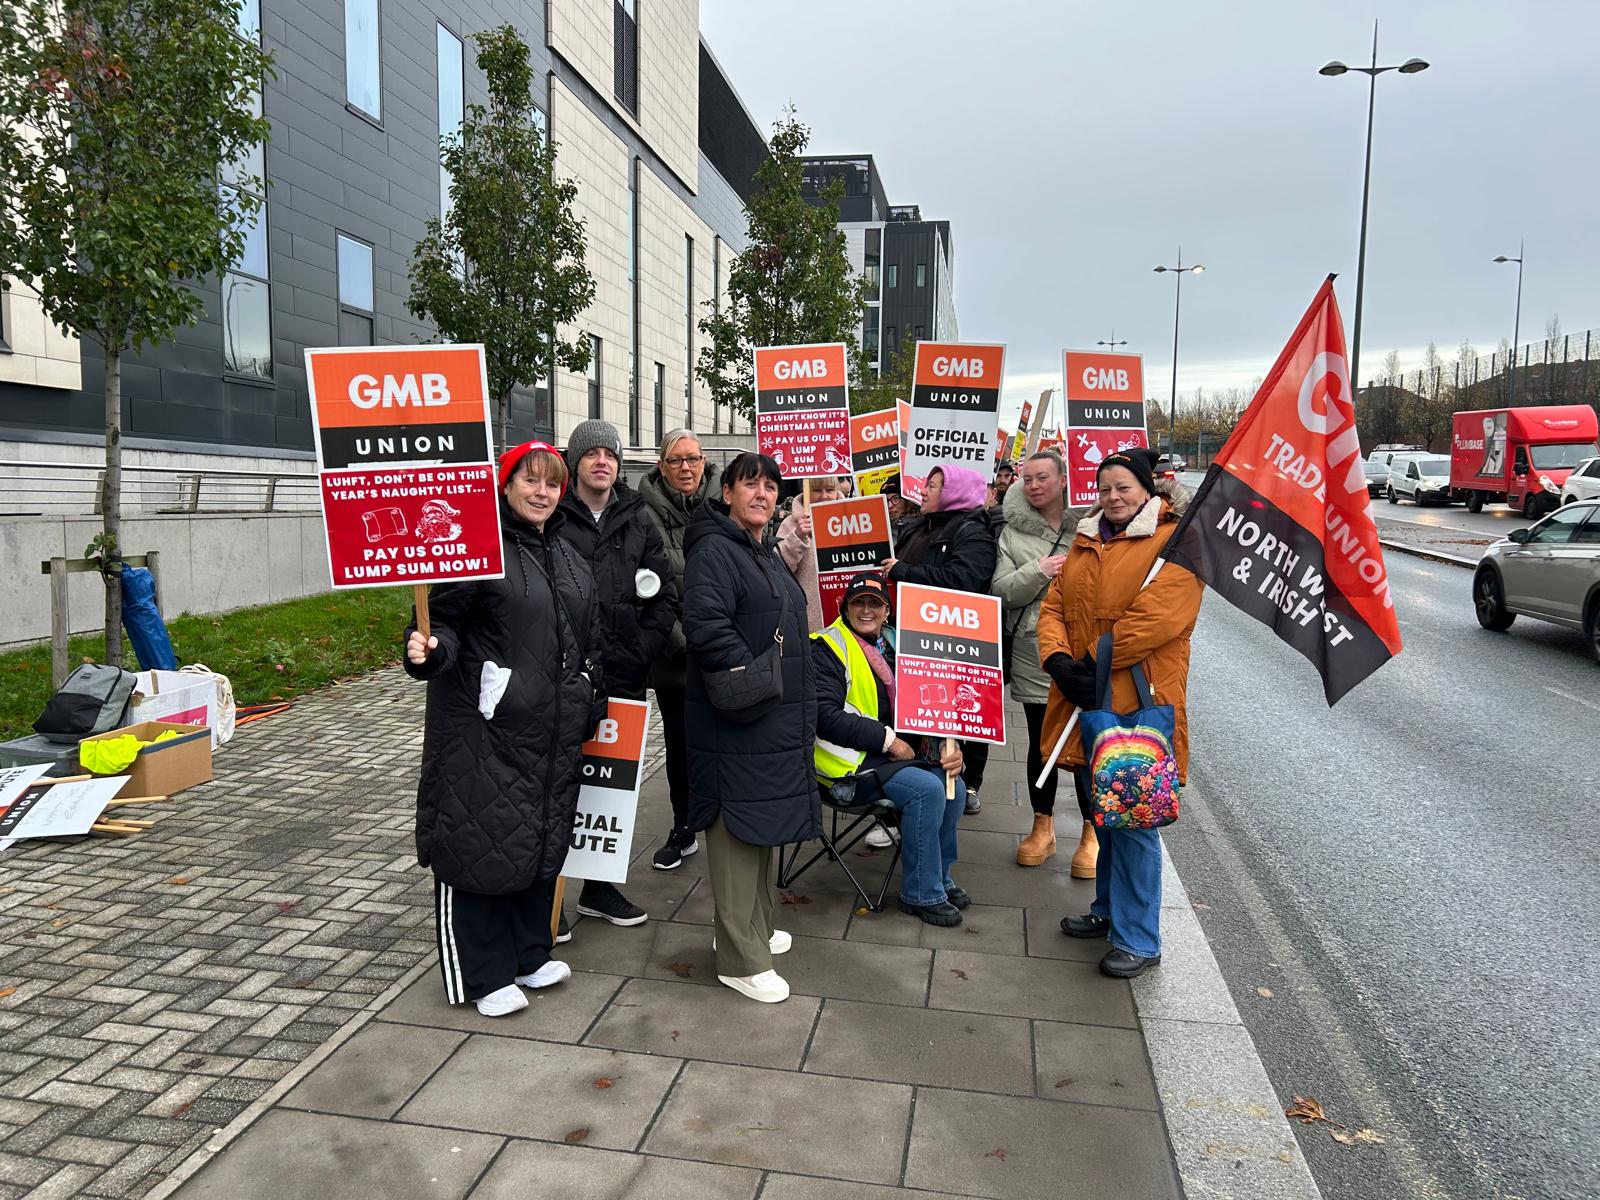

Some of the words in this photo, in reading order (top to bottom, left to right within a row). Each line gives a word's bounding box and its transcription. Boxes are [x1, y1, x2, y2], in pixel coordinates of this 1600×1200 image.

[773, 359, 828, 380] GMB
[932, 356, 984, 378] GMB
[1082, 366, 1129, 391] GMB
[348, 373, 450, 409] GMB
[776, 393, 828, 405] UNION
[930, 392, 980, 404] UNION
[1084, 408, 1130, 419] UNION
[760, 422, 815, 432] CHRISTMAS
[818, 421, 845, 429] TIME?
[355, 435, 454, 455] UNION
[775, 436, 795, 444] PAY
[797, 435, 809, 443] US
[811, 434, 831, 442] OUR
[914, 428, 988, 444] OFFICIAL
[791, 446, 816, 454] LUMP
[866, 450, 898, 463] UNIO
[915, 443, 985, 461] DISPUTE
[791, 465, 817, 473] NOW!
[326, 476, 370, 487] LUHFT,
[374, 474, 414, 484] DON'T
[418, 473, 434, 482] BE
[437, 472, 455, 481] ON
[459, 470, 487, 480] THIS
[331, 489, 378, 500] YEAR'S
[381, 486, 443, 497] NAUGHTY
[446, 484, 485, 494] LIST...
[827, 512, 873, 537] GMB
[363, 547, 398, 561] PAY
[404, 545, 426, 558] US
[431, 543, 467, 556] OUR
[831, 550, 876, 563] UNION
[344, 564, 391, 579] LUMP
[396, 561, 434, 575] SUM
[439, 557, 488, 573] NOW!
[1216, 506, 1300, 578] NORTH
[1299, 564, 1354, 647] WST
[1232, 557, 1253, 584] &
[1257, 571, 1319, 627] IRISH
[919, 602, 980, 630] GMB
[920, 639, 980, 657] UNION
[900, 659, 927, 669] LUHFT,
[930, 662, 955, 671] DON'T
[968, 667, 979, 675] ON
[981, 670, 998, 679] THIS
[902, 668, 931, 677] YEAR'S
[933, 671, 971, 682] NAUGHTY
[973, 677, 997, 686] LIST...
[917, 708, 940, 718] PAY
[943, 710, 958, 720] US
[961, 713, 983, 724] OUR
[904, 718, 934, 728] LUMP
[937, 721, 962, 732] SUM
[964, 724, 996, 736] NOW!
[1, 793, 39, 826] UNION
